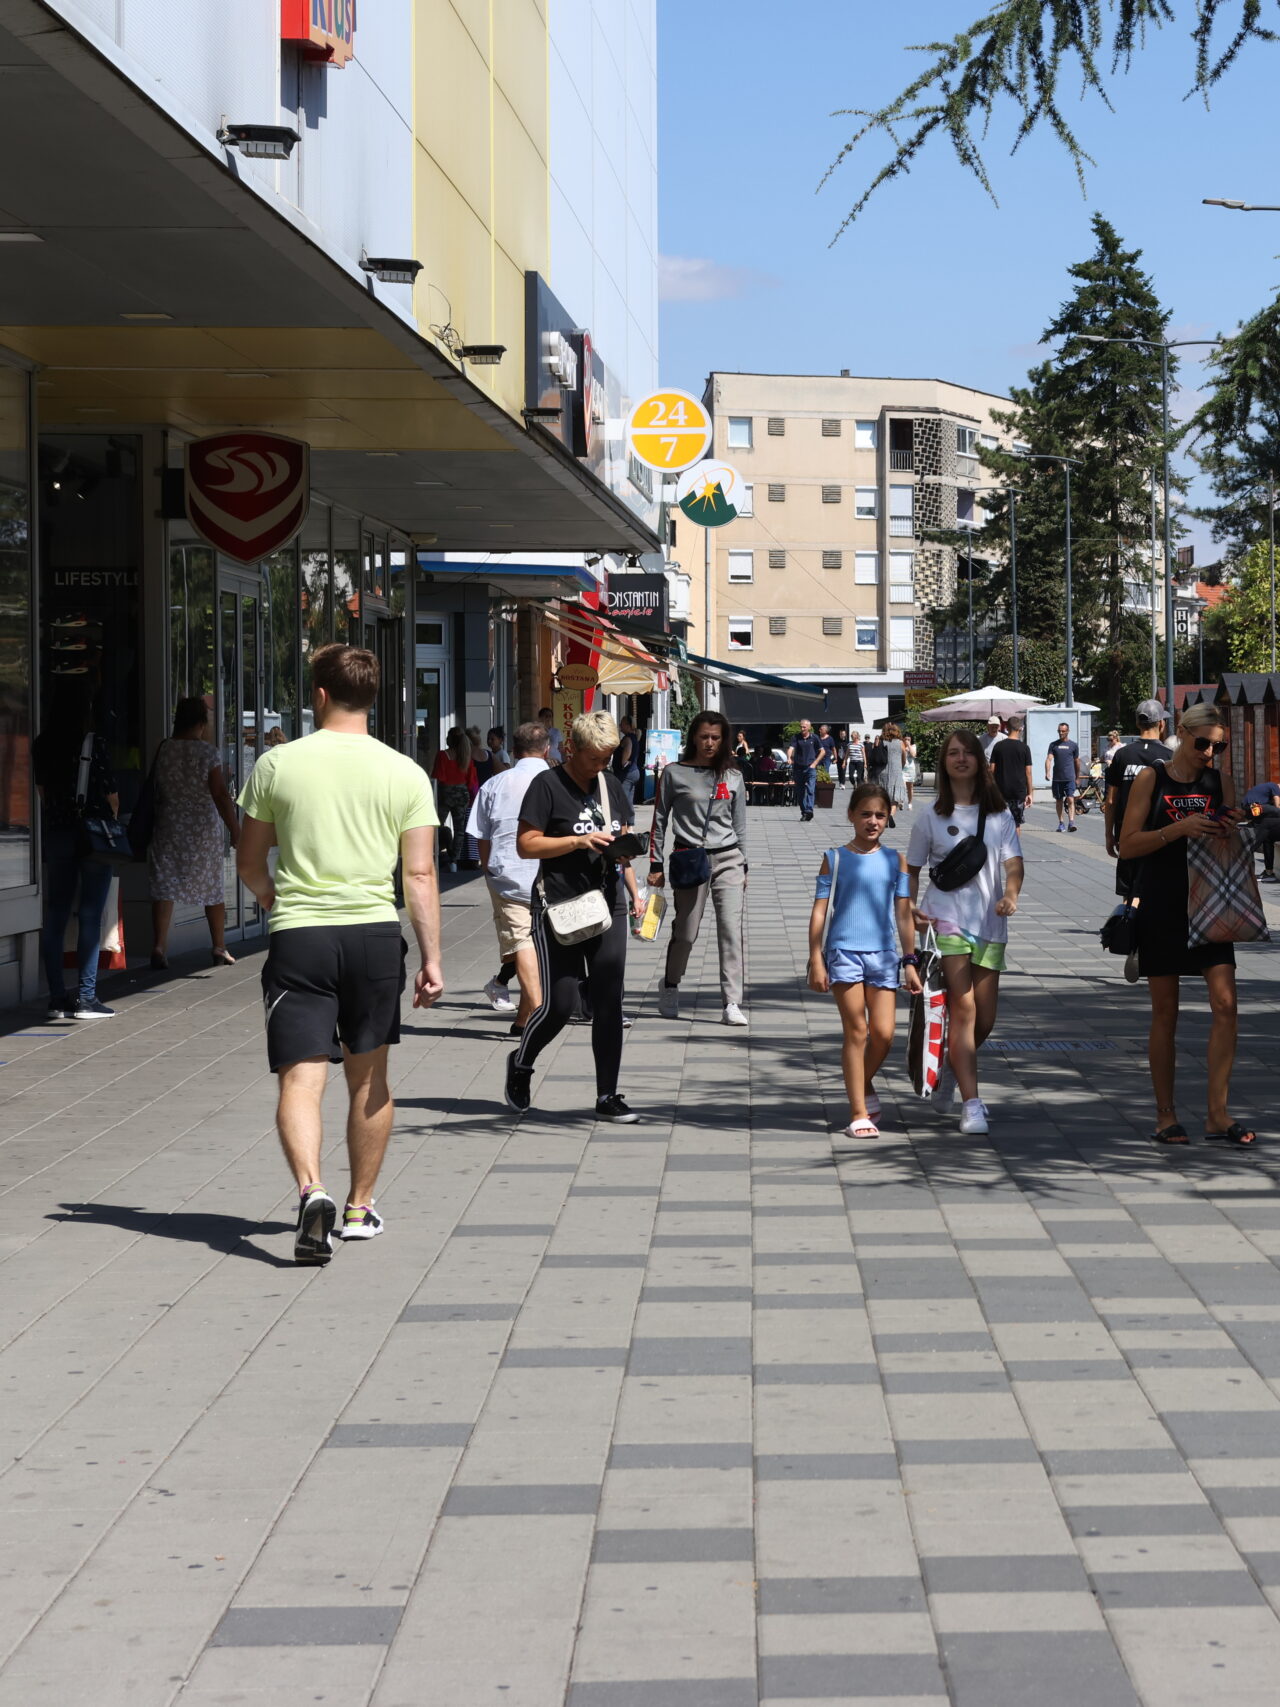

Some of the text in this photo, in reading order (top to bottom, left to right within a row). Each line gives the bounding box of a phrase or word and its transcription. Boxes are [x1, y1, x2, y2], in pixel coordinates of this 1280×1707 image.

[649, 401, 688, 426] 24
[660, 437, 679, 462] 7
[608, 591, 659, 607] ONSTANTIN
[715, 782, 731, 800] A
[1173, 798, 1206, 808] GUESS
[573, 819, 621, 834] ads
